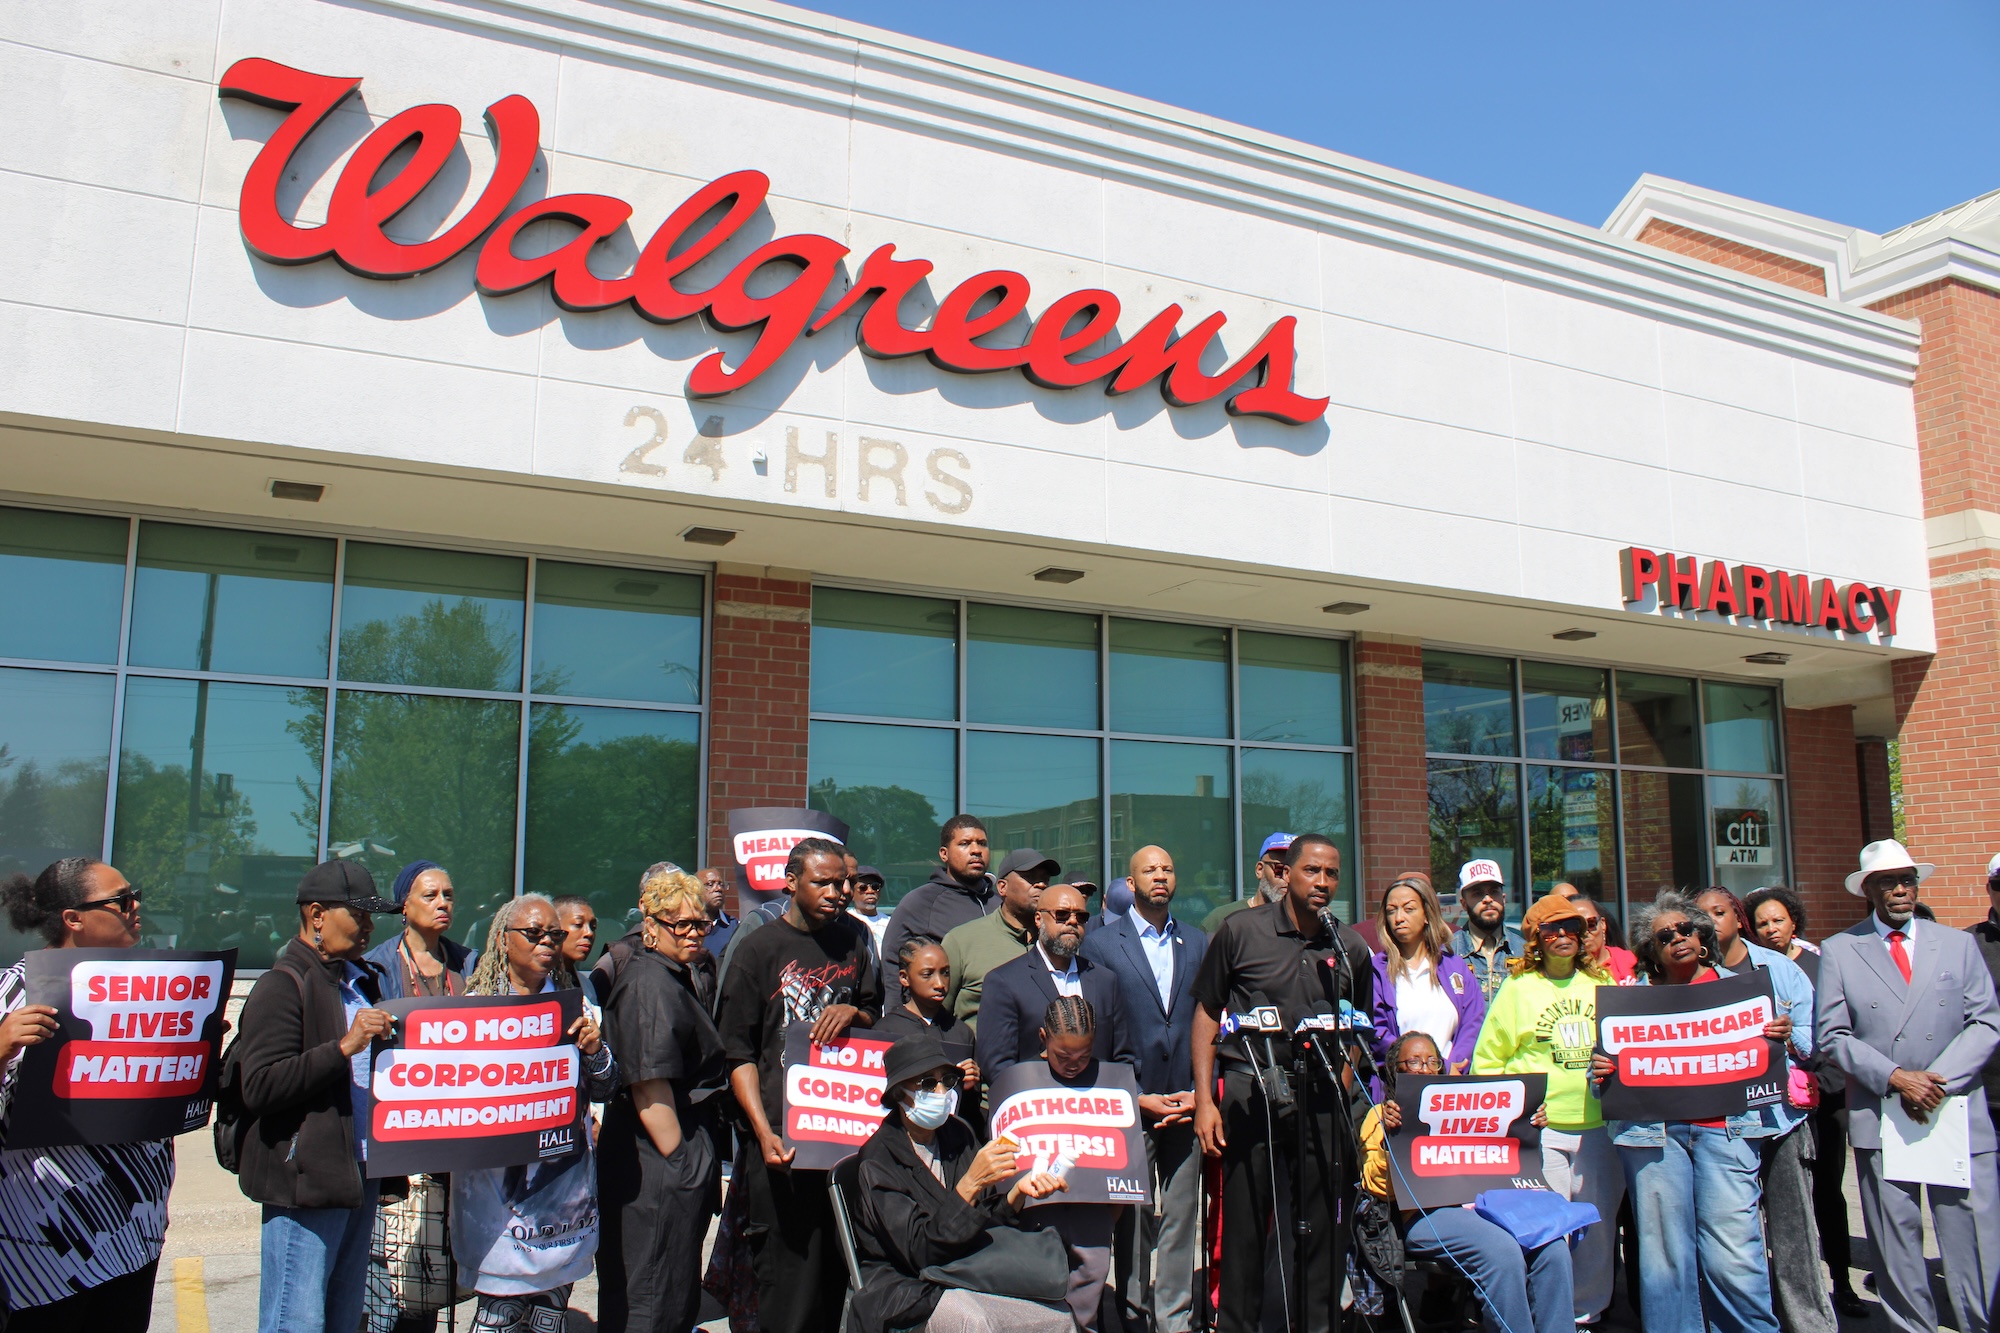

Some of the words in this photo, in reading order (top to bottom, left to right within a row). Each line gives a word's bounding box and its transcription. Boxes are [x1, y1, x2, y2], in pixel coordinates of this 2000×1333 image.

[220, 56, 1330, 424] Walgreens
[620, 405, 727, 482] 24
[783, 426, 974, 514] HRS
[1620, 546, 1902, 636] PHARMACY
[1726, 817, 1761, 846] citi
[1729, 848, 1758, 863] ATM
[754, 863, 787, 881] MA
[1469, 863, 1495, 879] ROSE
[88, 975, 211, 1002] SENIOR
[108, 1011, 194, 1039] LIVES
[420, 1020, 468, 1044] NO
[475, 1013, 554, 1042] MORE
[1236, 1014, 1257, 1024] WGN
[1612, 1006, 1764, 1043] HEALTHCARE
[70, 1055, 203, 1083] MATTER!
[820, 1046, 858, 1067] NO
[862, 1049, 886, 1069] M
[1630, 1049, 1758, 1076] MATTERS!
[389, 1058, 570, 1088] CORPORATE
[185, 1098, 209, 1119] HALL
[383, 1096, 571, 1130] ABANDONMENT
[1429, 1091, 1511, 1112] SENIOR
[996, 1097, 1124, 1135] HEALTHCARE
[1439, 1117, 1499, 1135] LIVES
[538, 1127, 574, 1148] HALL
[1014, 1133, 1115, 1158] ATTERS!
[1419, 1145, 1510, 1165] MATTER!
[533, 1240, 553, 1251] YOUR
[555, 1236, 577, 1248] FIRST
